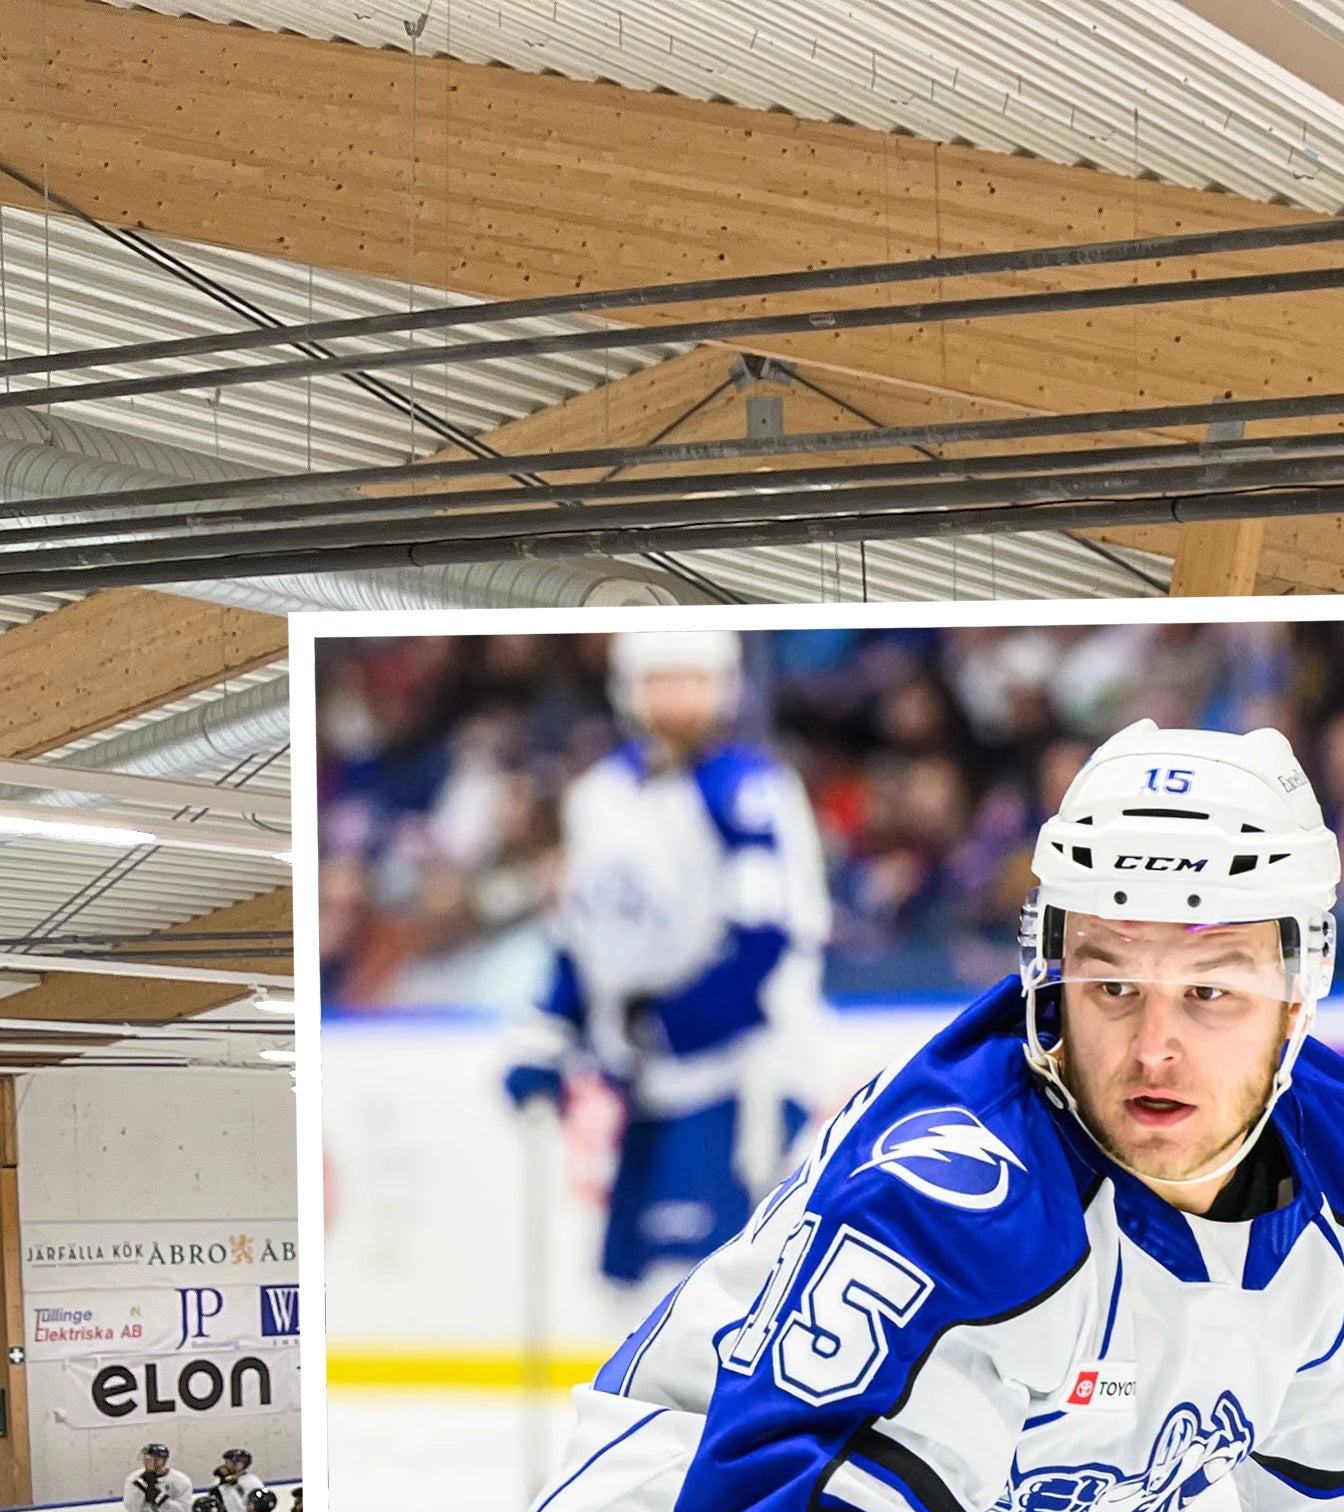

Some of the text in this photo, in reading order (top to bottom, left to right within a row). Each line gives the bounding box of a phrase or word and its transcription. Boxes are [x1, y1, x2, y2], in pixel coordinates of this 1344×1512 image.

[1140, 767, 1196, 795] 15
[1113, 854, 1209, 873] CCM
[112, 1241, 144, 1259] KÖK
[147, 1241, 227, 1266] ÅBRO
[173, 1287, 224, 1350] JP
[265, 1288, 299, 1334] W
[720, 1210, 937, 1407] 15
[121, 1324, 143, 1339] AB
